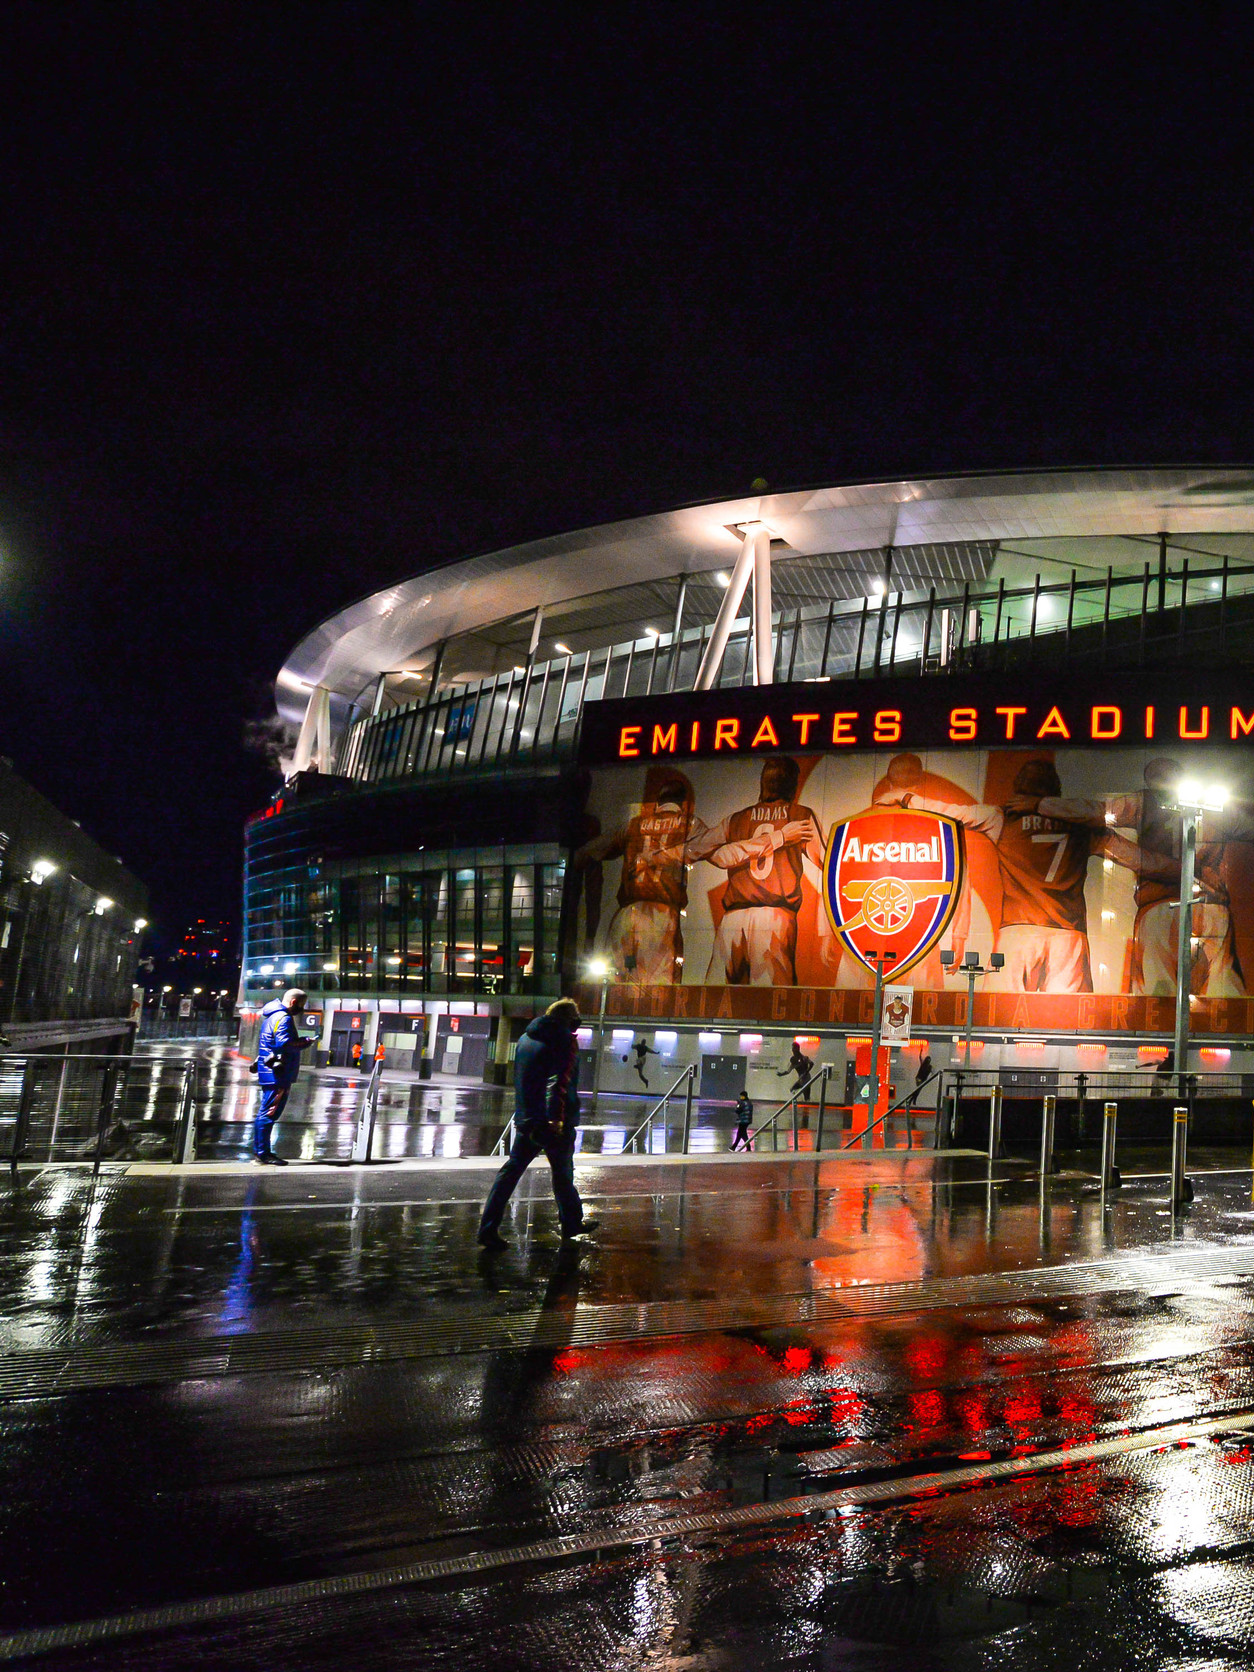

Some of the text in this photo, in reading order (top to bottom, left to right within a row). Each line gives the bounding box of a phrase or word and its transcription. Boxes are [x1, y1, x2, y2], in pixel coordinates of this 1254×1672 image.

[618, 709, 902, 758] EMIRATES
[750, 804, 788, 822] ADAMS
[1021, 814, 1070, 831] BRA
[842, 835, 941, 864] Arsenal
[1031, 833, 1069, 882] 7
[572, 984, 734, 1018] ICTORIA
[771, 988, 1031, 1027] CONCRDIA
[306, 1015, 316, 1026] G
[411, 1018, 419, 1031] F
